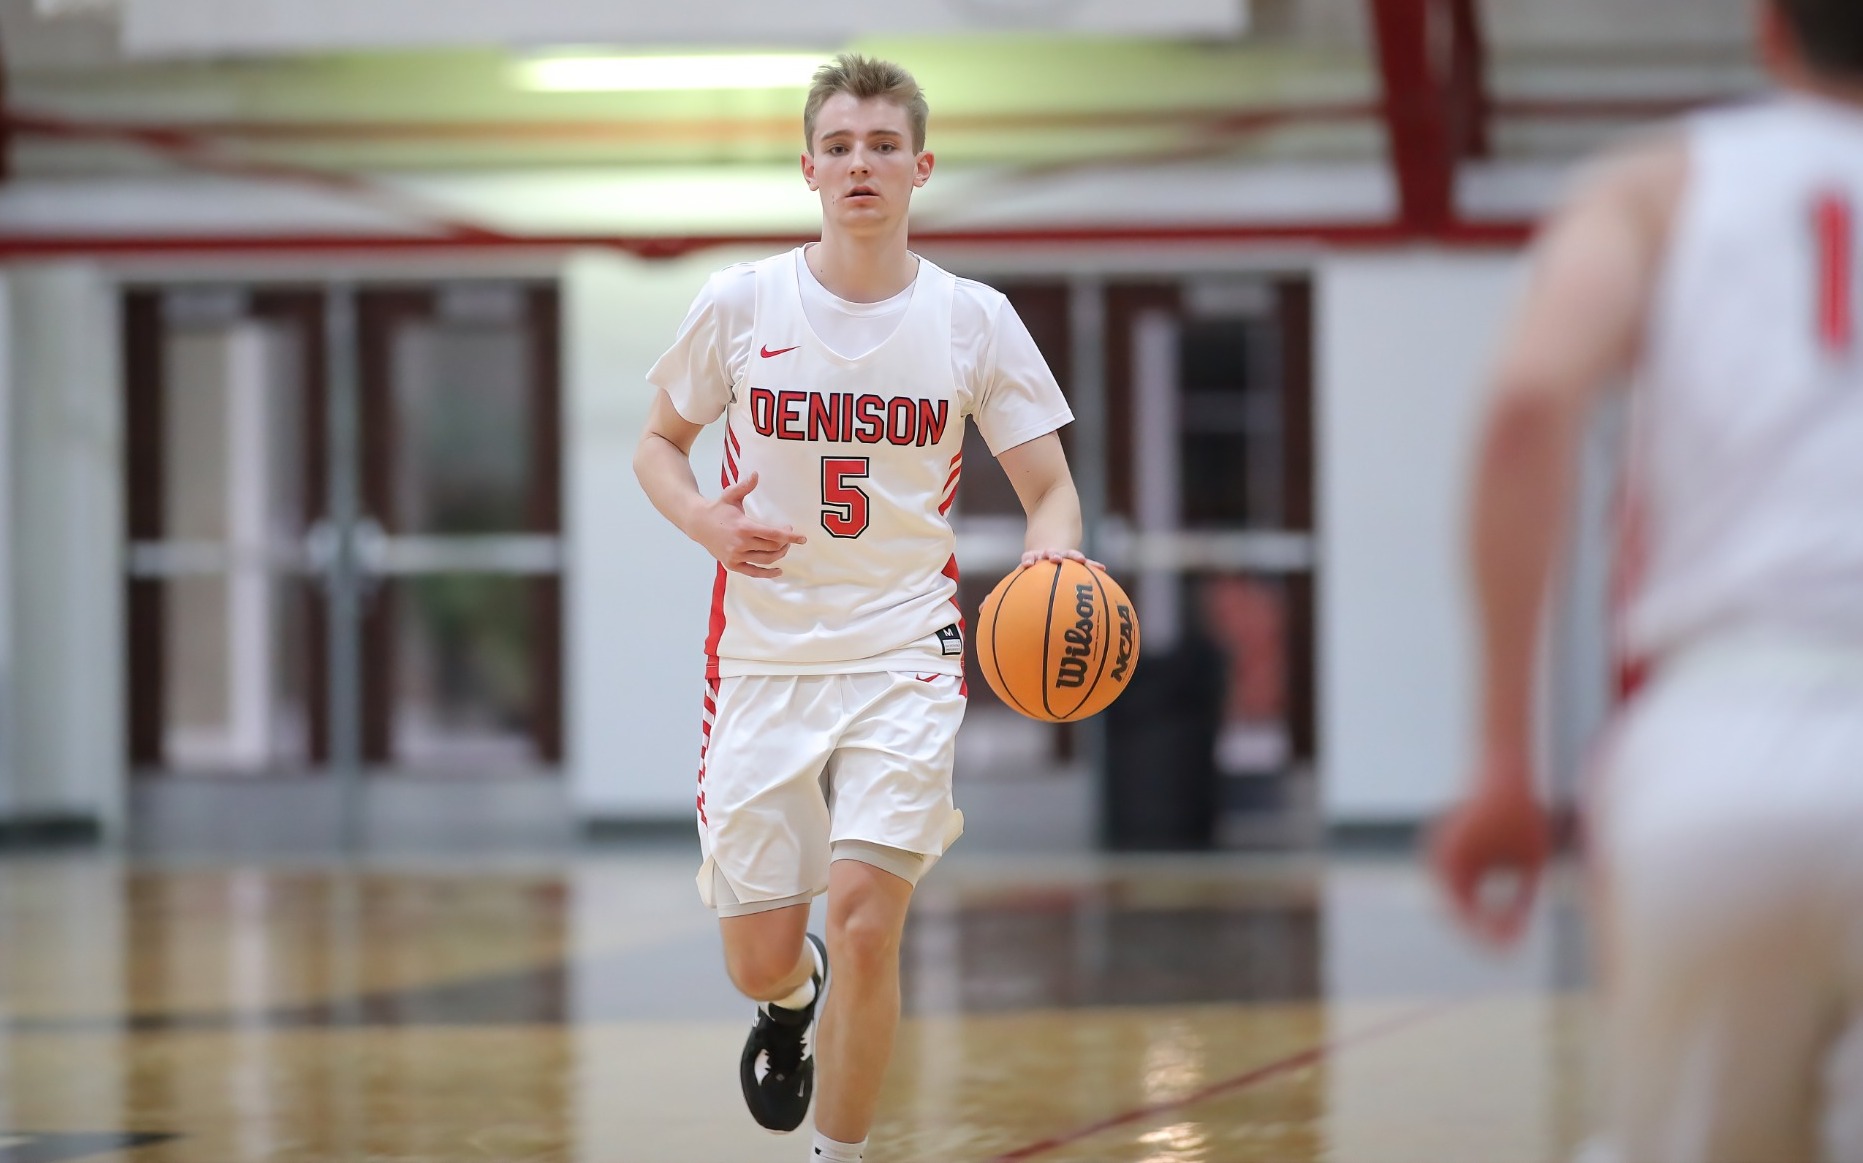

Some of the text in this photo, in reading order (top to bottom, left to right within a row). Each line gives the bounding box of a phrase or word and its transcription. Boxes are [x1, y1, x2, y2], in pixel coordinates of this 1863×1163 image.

[751, 387, 948, 447] DENISON
[821, 456, 869, 539] 5
[943, 628, 954, 637] M
[1056, 584, 1094, 689] Wilson
[1111, 605, 1132, 682] NCAA
